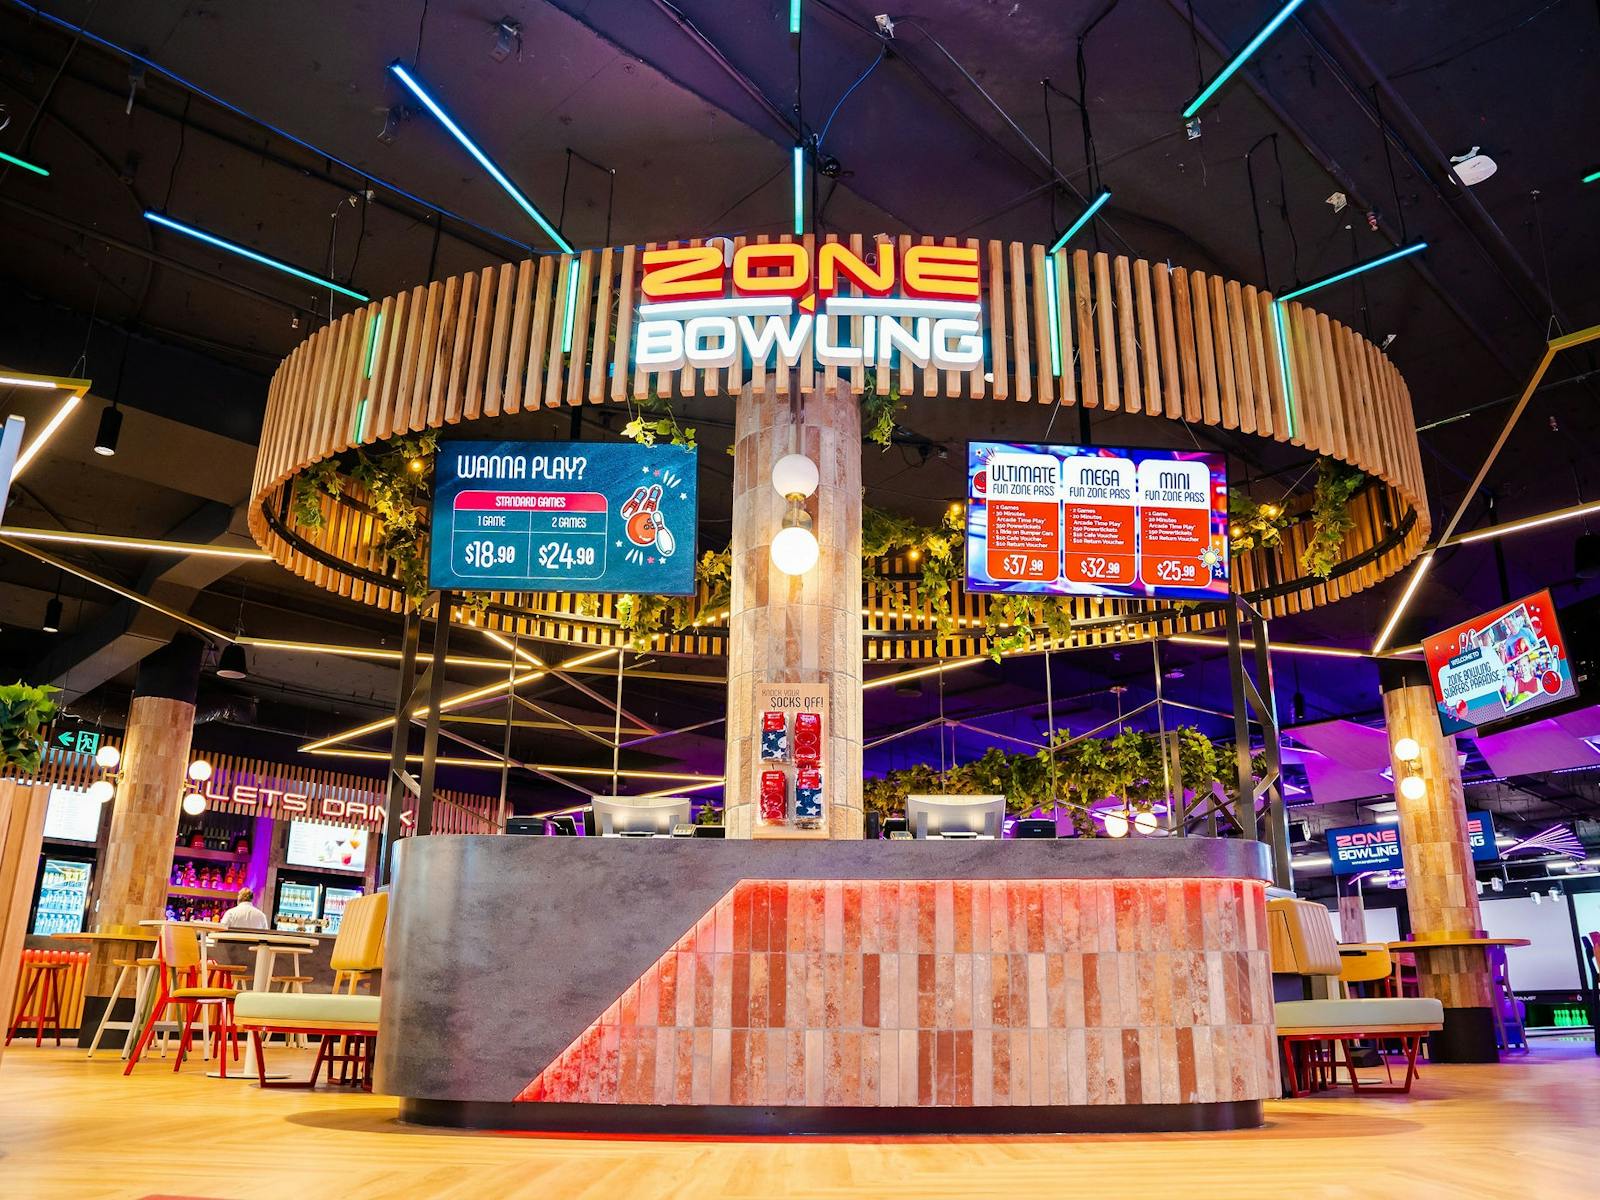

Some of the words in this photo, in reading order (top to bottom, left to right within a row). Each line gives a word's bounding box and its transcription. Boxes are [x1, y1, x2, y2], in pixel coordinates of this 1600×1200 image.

[639, 242, 980, 300] ZONE
[635, 314, 983, 372] BOWLING
[457, 455, 526, 478] WANNA
[532, 456, 587, 480] PLAY?
[992, 465, 1056, 484] ULTIMATE
[1080, 468, 1120, 486] MEGA
[1160, 472, 1190, 490] MINI
[992, 484, 1008, 494] FUN
[1010, 484, 1031, 496] ZONE
[1034, 486, 1055, 496] PASS
[1070, 486, 1085, 497] FUN
[1087, 488, 1108, 498] ZONE
[1110, 488, 1130, 500] PASS
[1145, 490, 1160, 500] FUN
[1162, 491, 1182, 502] ZONE
[1184, 492, 1205, 502] PASS
[496, 496, 536, 508] STANDARD
[538, 497, 566, 508] GAMES
[478, 515, 482, 526] 1
[483, 516, 506, 527] GAME
[552, 517, 558, 528] 2
[558, 517, 586, 528] GAMES
[465, 541, 516, 568] $18.90
[538, 542, 594, 570] $24.90
[1003, 554, 1044, 575] $37.90
[1080, 558, 1120, 578] $32.90
[1156, 560, 1196, 581] $25.90
[1450, 653, 1473, 666] WELCOME
[1447, 672, 1462, 686] ZONE
[1463, 662, 1491, 680] BOWLING
[1444, 682, 1470, 699] SURFERS
[1470, 670, 1500, 690] PARADISE
[770, 697, 801, 707] SOCKS
[804, 697, 824, 707] OFF!
[206, 781, 308, 812] LETS
[1336, 830, 1397, 847] ZONE
[1338, 845, 1399, 861] BOWLING
